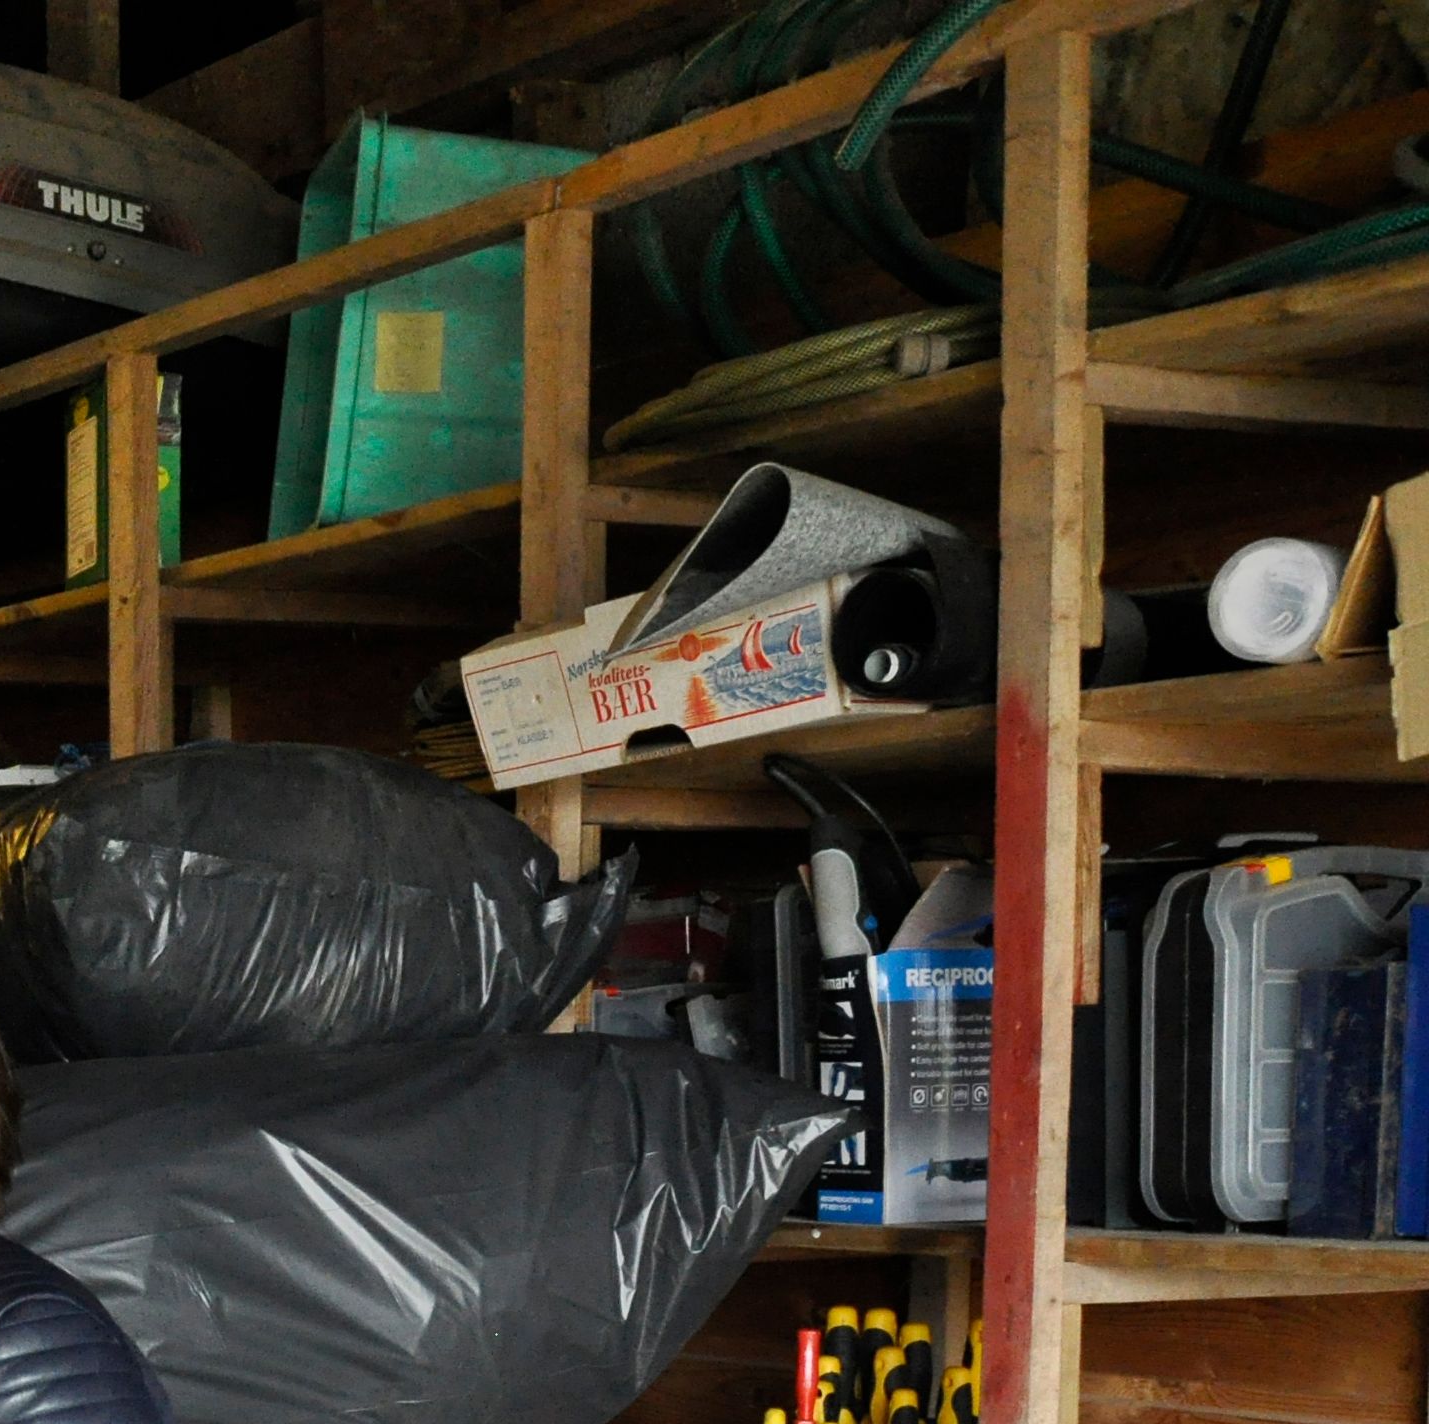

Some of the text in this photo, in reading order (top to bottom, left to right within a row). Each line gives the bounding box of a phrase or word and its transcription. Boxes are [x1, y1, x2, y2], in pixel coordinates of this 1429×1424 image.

[38, 180, 144, 232] THULE
[587, 664, 652, 689] kvalitets-
[590, 678, 658, 724] BÆR
